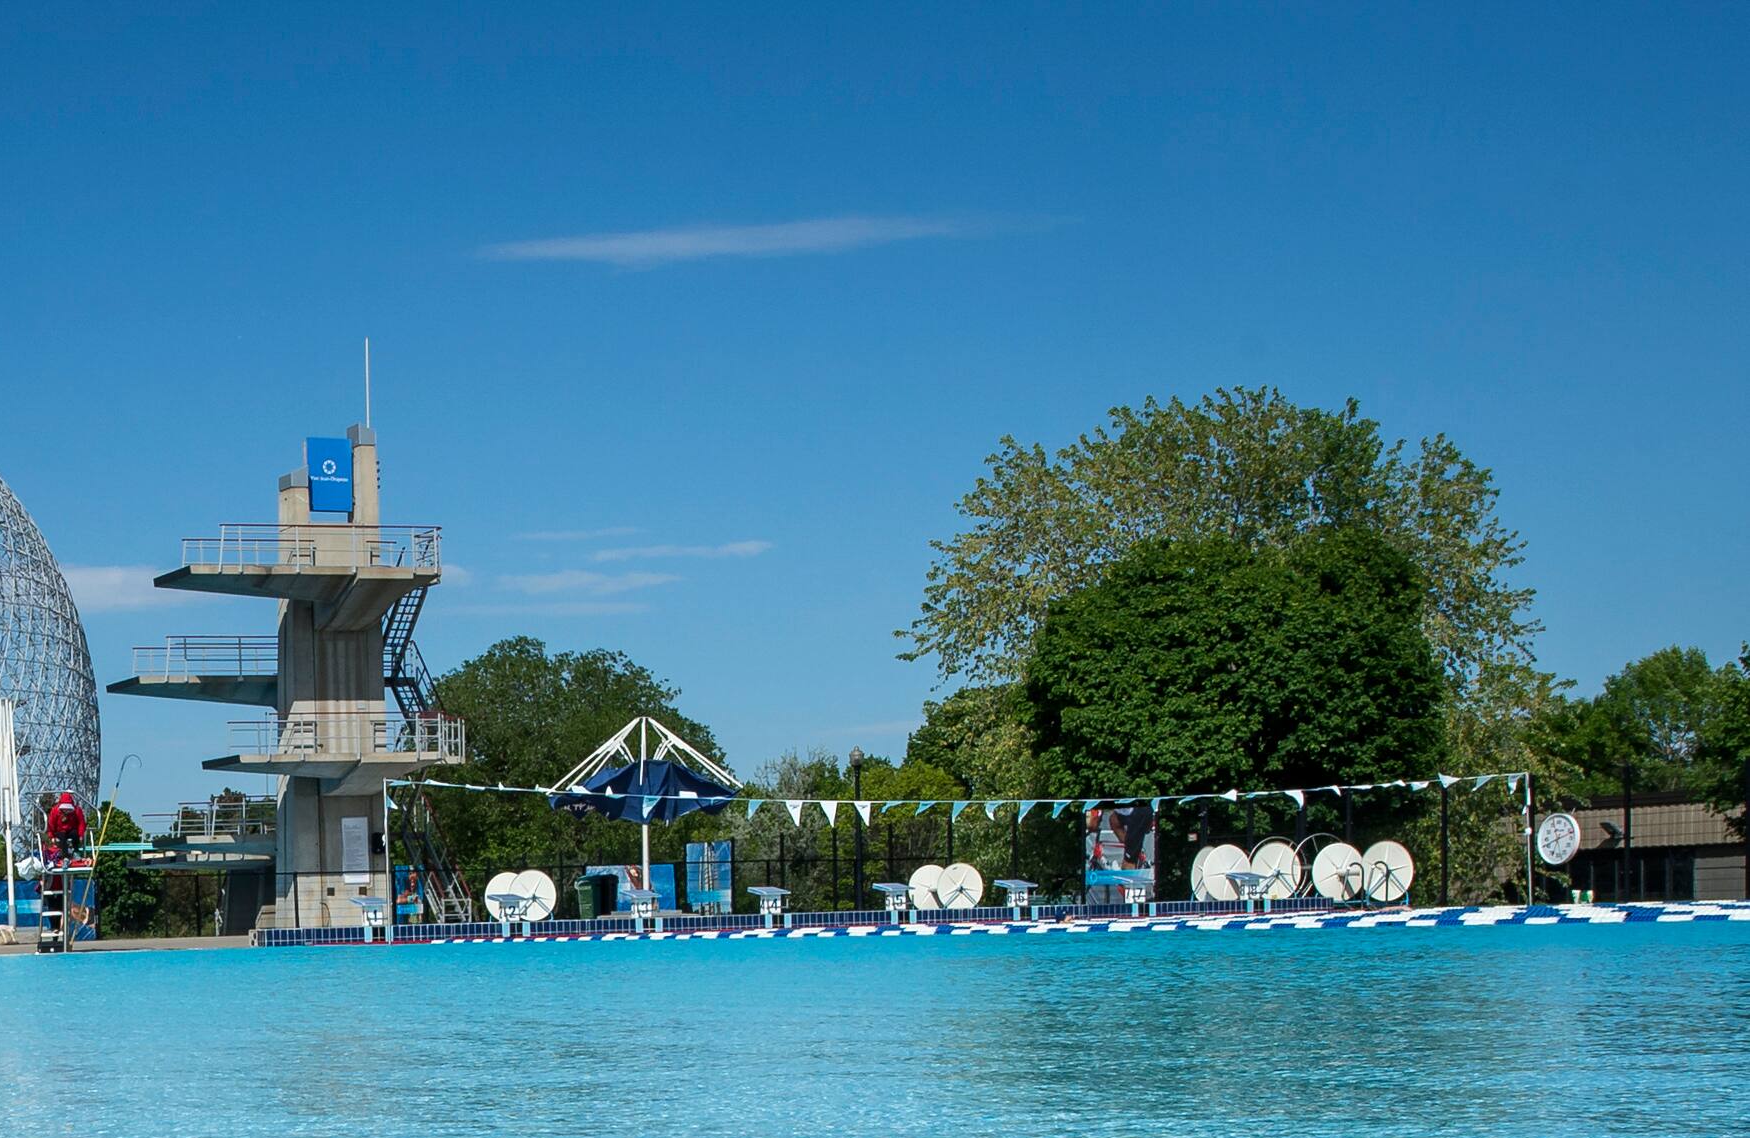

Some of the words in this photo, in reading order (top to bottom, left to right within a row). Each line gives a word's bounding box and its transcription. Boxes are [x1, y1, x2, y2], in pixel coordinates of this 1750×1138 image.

[896, 894, 903, 907] 5
[1018, 891, 1025, 904] 6
[508, 905, 516, 919] 2
